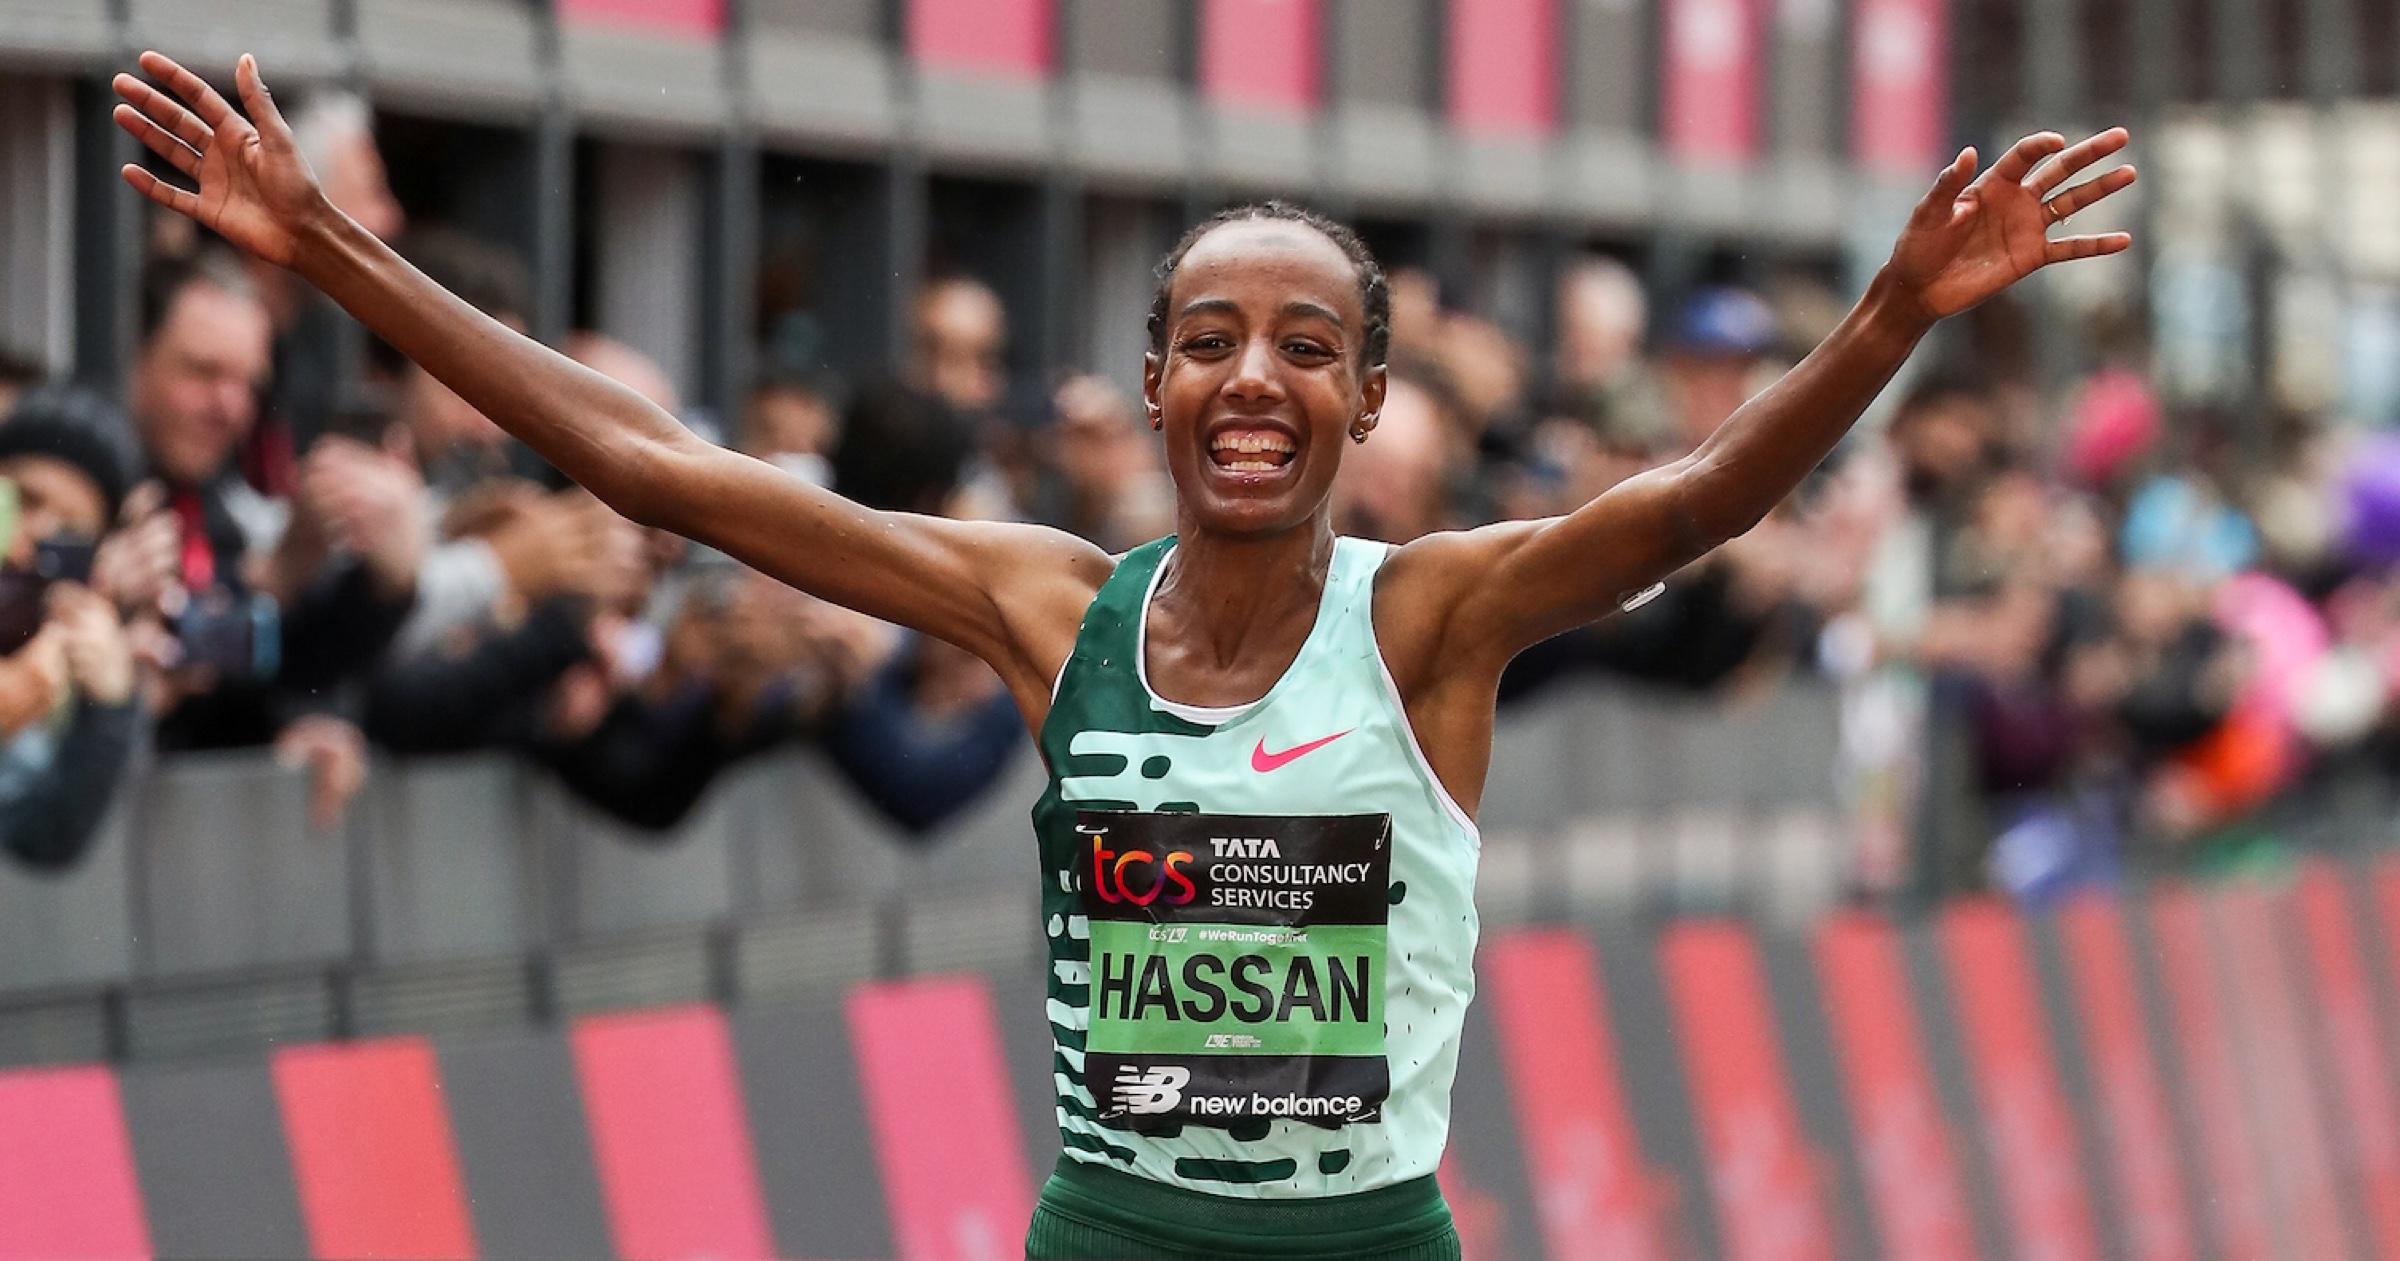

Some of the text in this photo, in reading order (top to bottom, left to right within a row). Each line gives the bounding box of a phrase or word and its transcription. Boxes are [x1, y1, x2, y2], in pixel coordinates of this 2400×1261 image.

[1210, 838, 1281, 858] TATA
[1094, 835, 1196, 905] tcs
[1209, 862, 1371, 885] CONSULTANCY
[1211, 888, 1313, 910] SERVICES
[1099, 952, 1370, 1023] HASSAN
[1190, 1092, 1363, 1116] new balance
